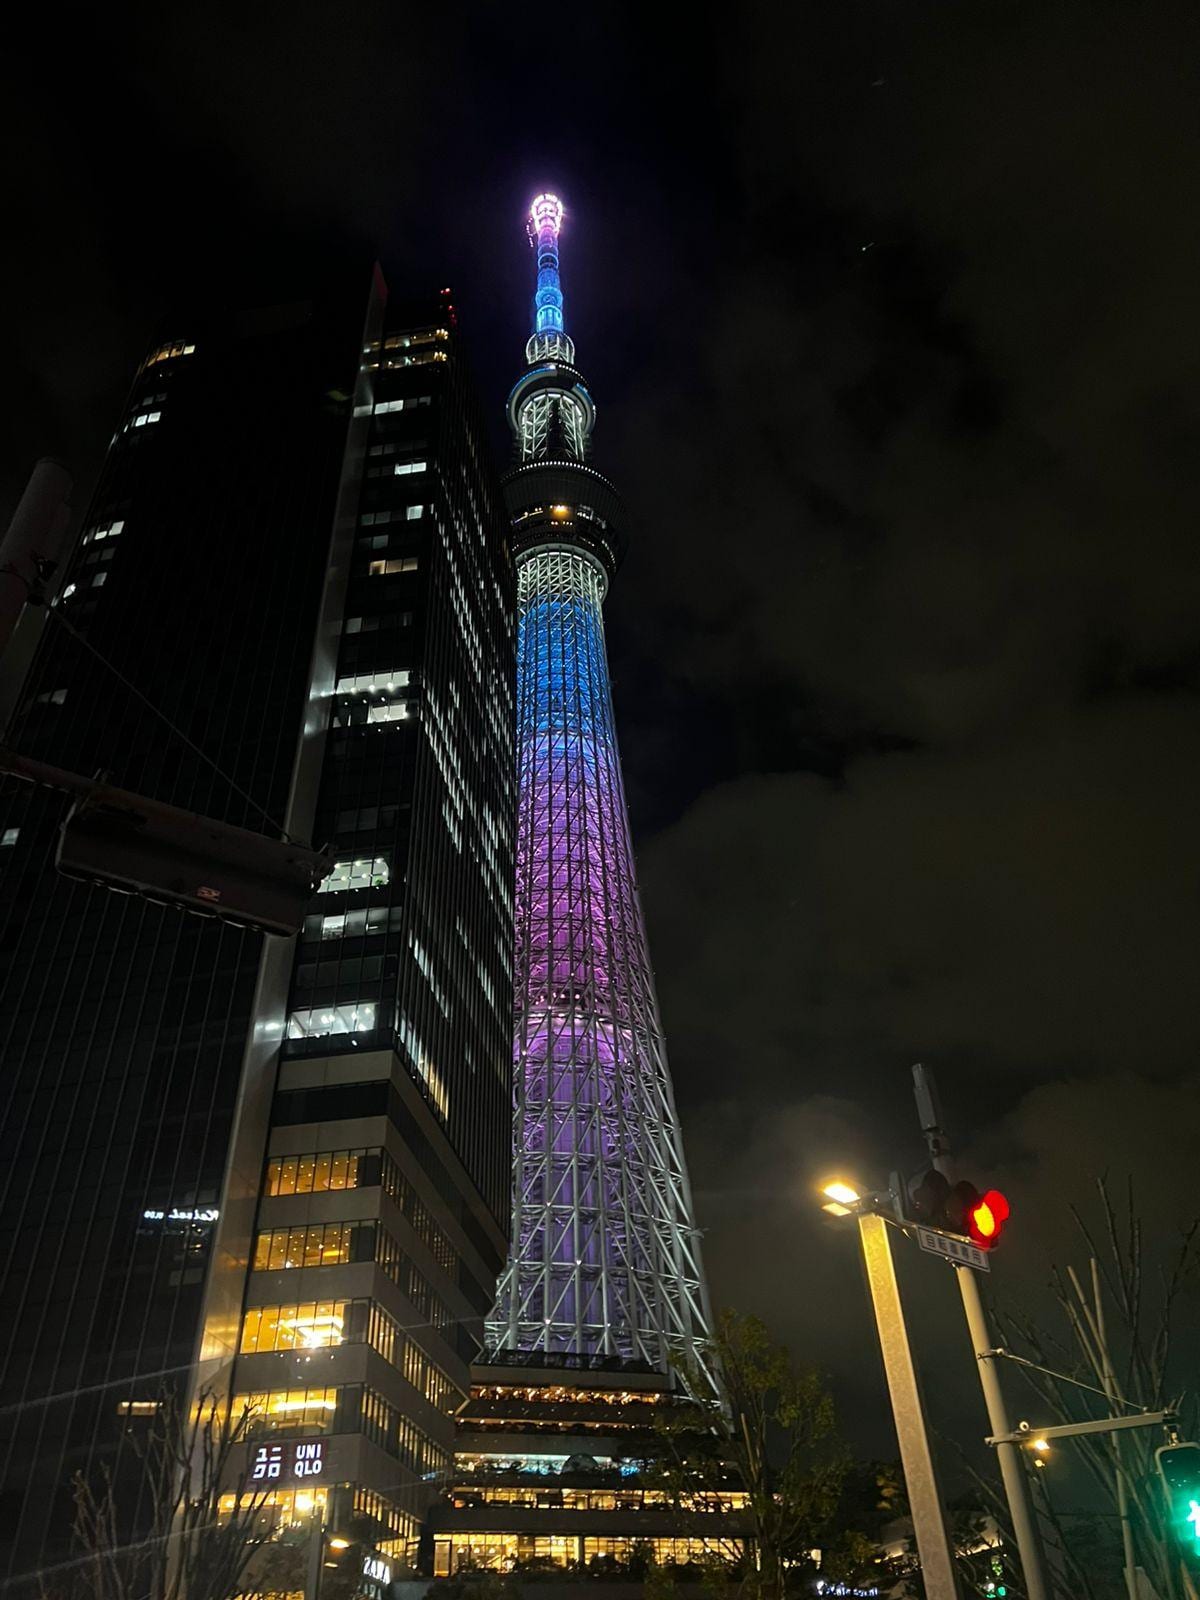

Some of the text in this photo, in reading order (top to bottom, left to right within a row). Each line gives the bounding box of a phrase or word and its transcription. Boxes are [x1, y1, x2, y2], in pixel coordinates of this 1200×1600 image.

[256, 1447, 281, 1462] ユニ
[296, 1444, 322, 1460] UNI
[253, 1463, 281, 1479] クロ
[294, 1460, 322, 1478] QLO
[363, 1556, 391, 1585] ZARA
